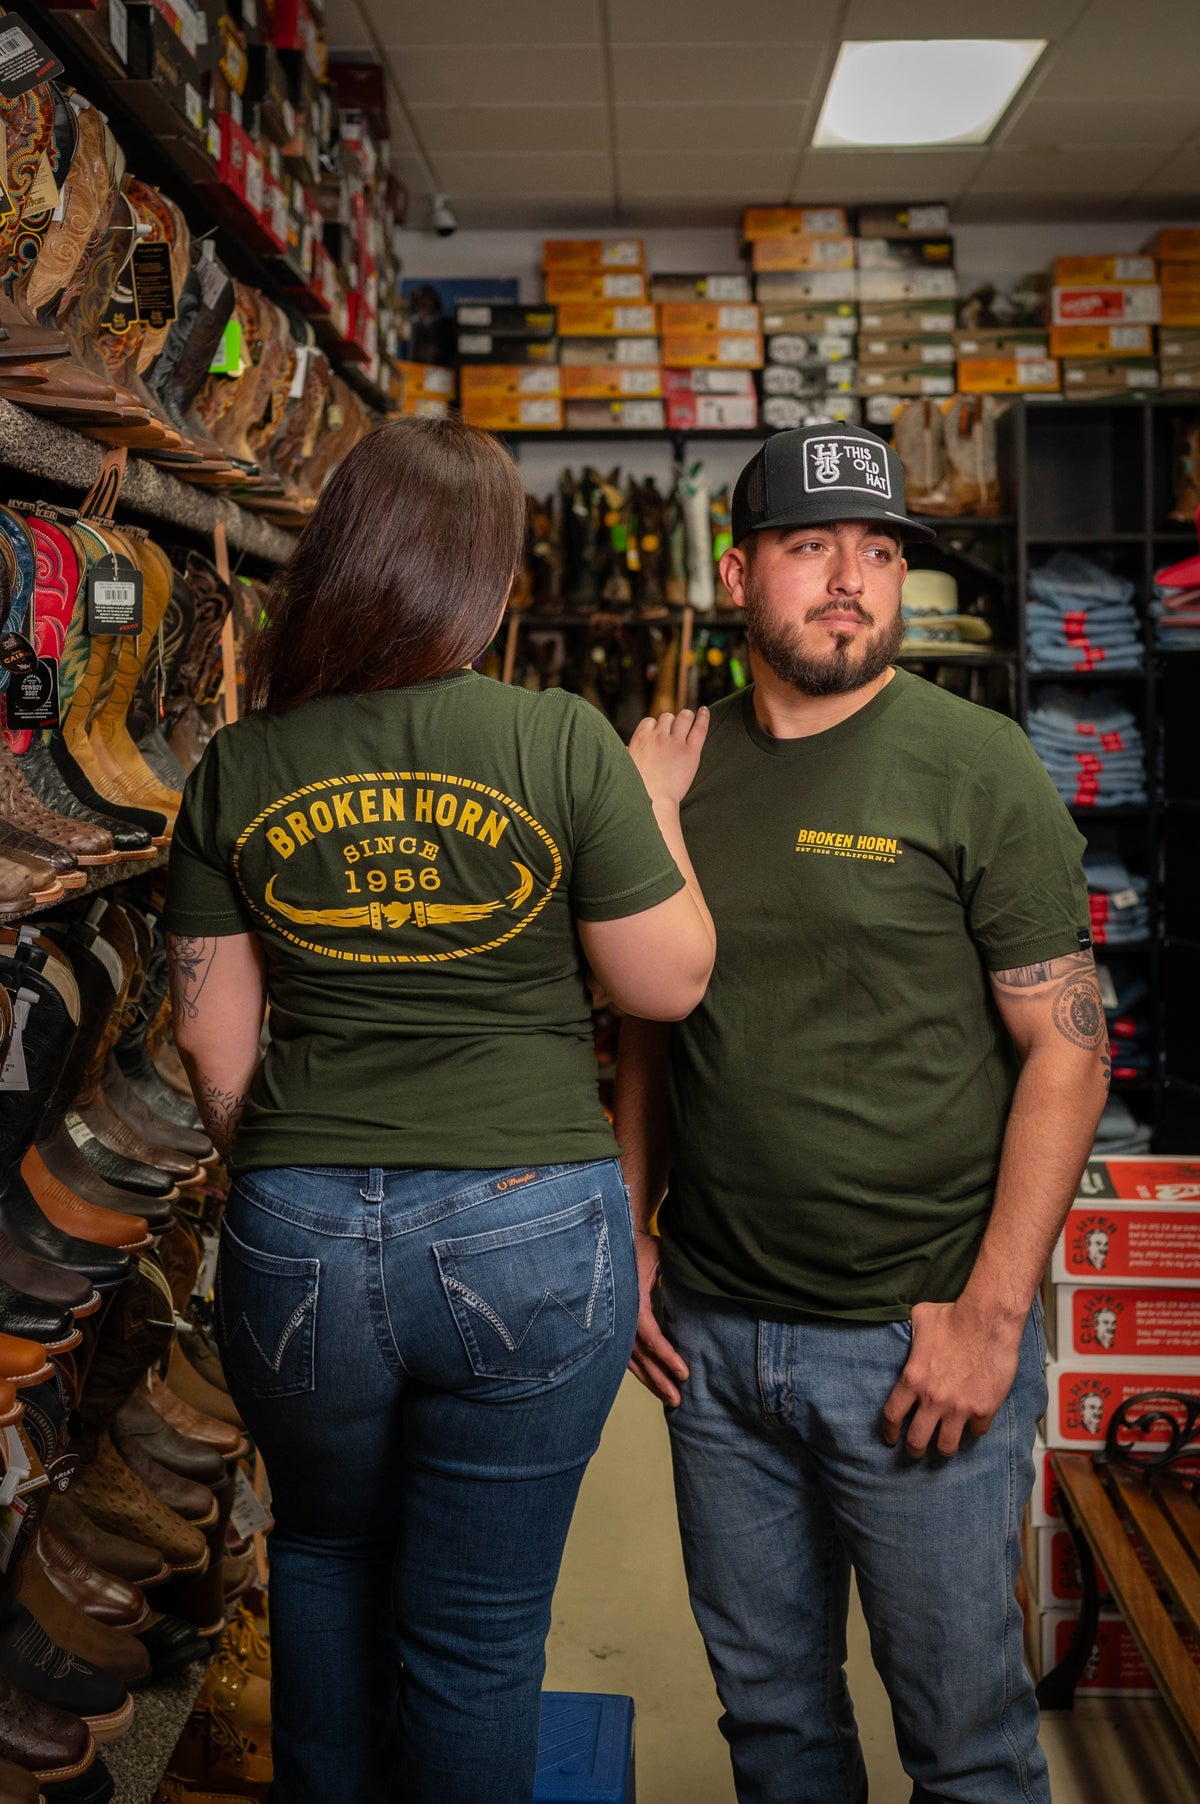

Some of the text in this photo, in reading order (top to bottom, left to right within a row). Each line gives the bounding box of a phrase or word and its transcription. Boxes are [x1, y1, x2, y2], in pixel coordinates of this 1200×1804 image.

[843, 445, 871, 460] THIS
[853, 459, 879, 474] OLD
[865, 473, 886, 490] HAT
[265, 788, 510, 860] BROKEN HORN
[343, 836, 440, 864] SINCE
[798, 829, 854, 848] BROKEN
[857, 835, 897, 854] HORN
[834, 851, 895, 863] CALIFORNIA
[344, 867, 441, 894] 1956
[1076, 1215, 1117, 1235] HYER
[1070, 1378, 1111, 1399] HYER
[53, 1467, 76, 1481] ARIAT
